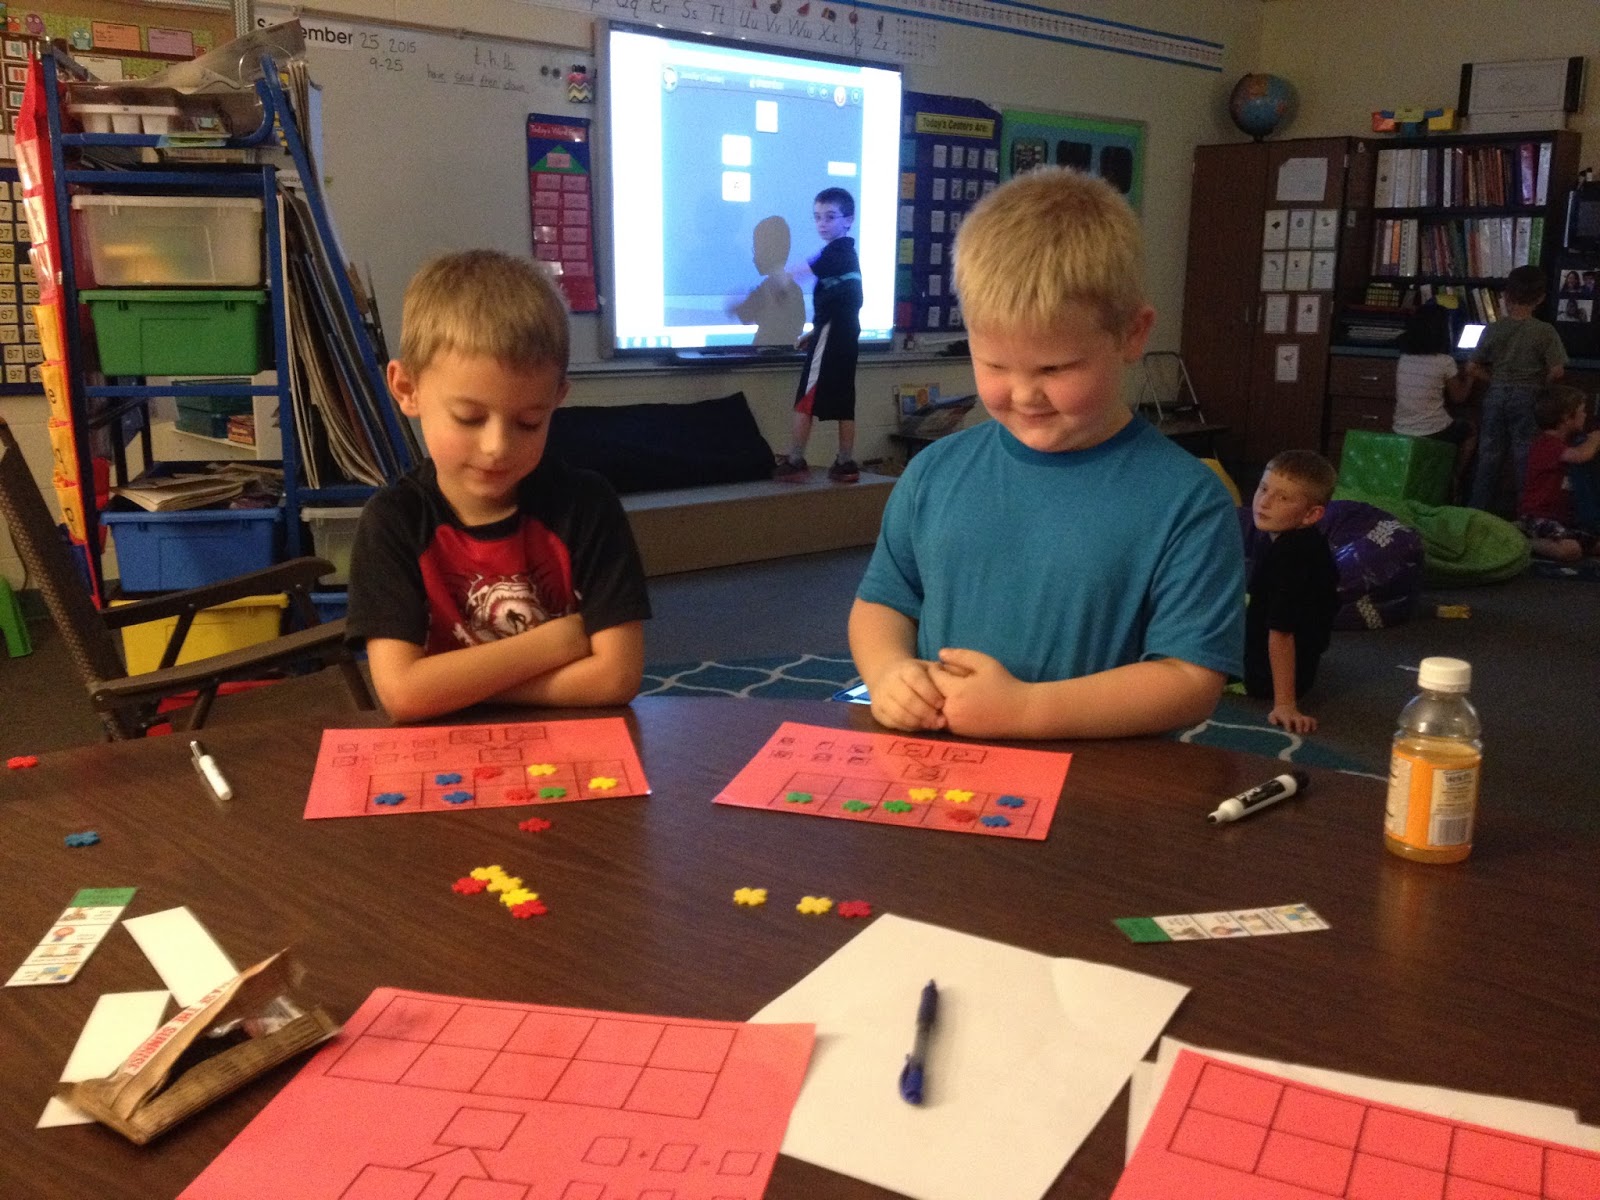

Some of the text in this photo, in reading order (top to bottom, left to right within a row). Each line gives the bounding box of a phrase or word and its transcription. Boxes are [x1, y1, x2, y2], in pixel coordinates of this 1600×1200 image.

[681, 0, 698, 20] Ss
[710, 4, 725, 24] Tt
[739, 9, 758, 30] Uu
[765, 14, 781, 34] Vv
[788, 18, 813, 39] Ww
[818, 24, 838, 43] Xx
[873, 33, 888, 50] Zz
[388, 38, 417, 54] 2015
[1, 288, 40, 299] 57 58
[1, 309, 14, 320] 67
[2, 329, 16, 340] 77
[6, 349, 41, 360] 87 88
[9, 370, 23, 380] 97
